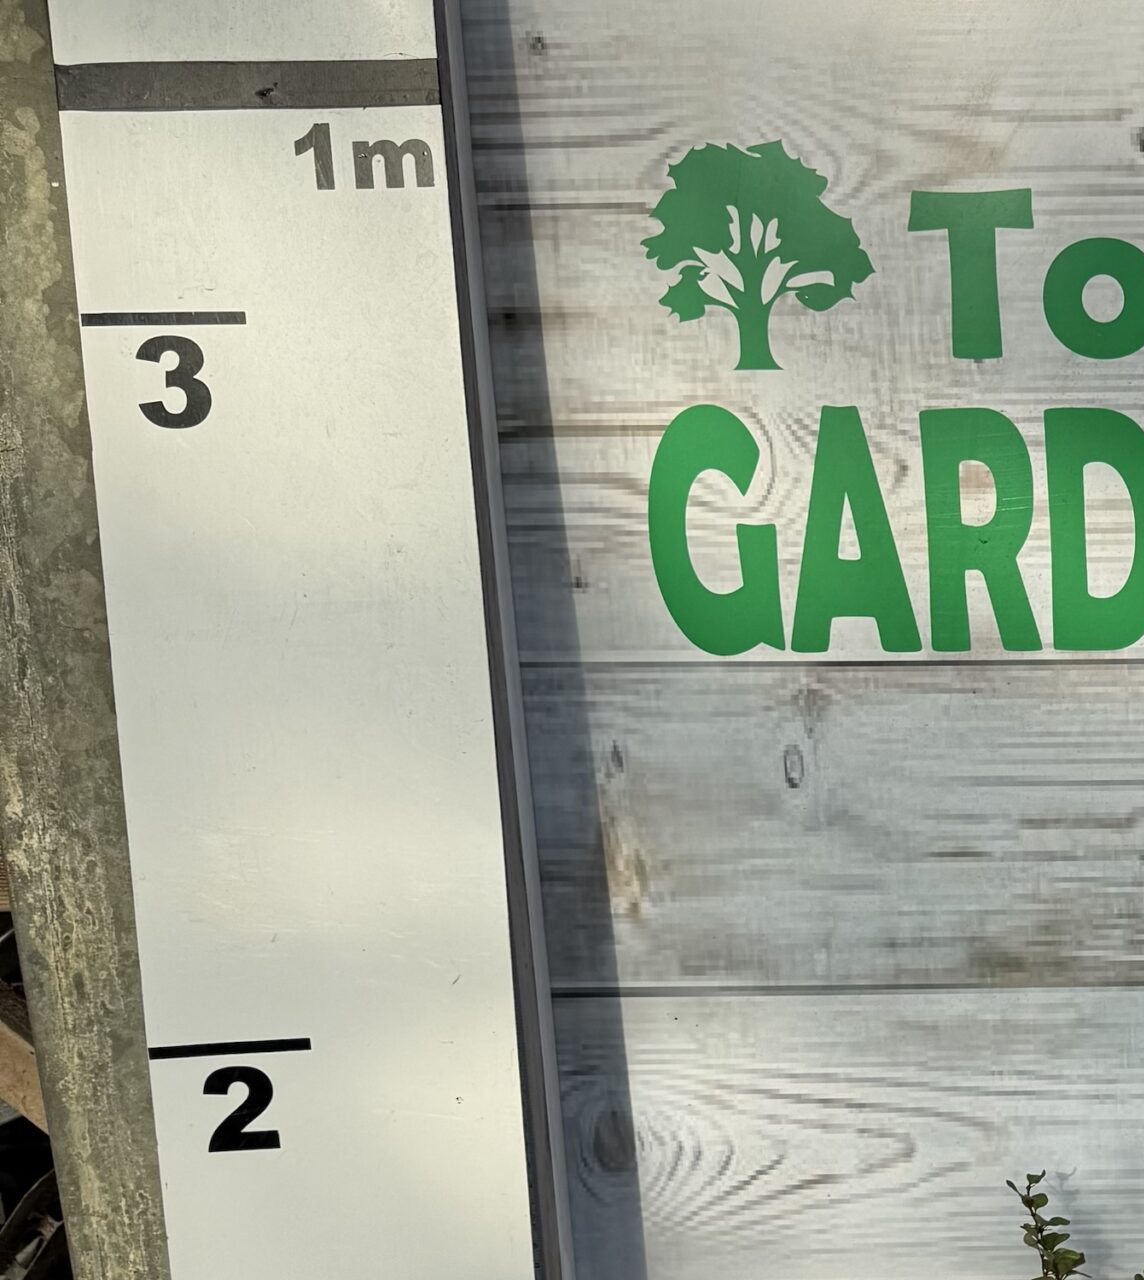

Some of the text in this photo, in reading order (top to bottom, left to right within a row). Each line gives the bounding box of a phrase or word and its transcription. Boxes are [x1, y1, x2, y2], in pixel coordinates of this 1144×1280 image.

[295, 122, 435, 190] 1m
[135, 335, 212, 429] 3
[202, 1065, 281, 1153] 2
